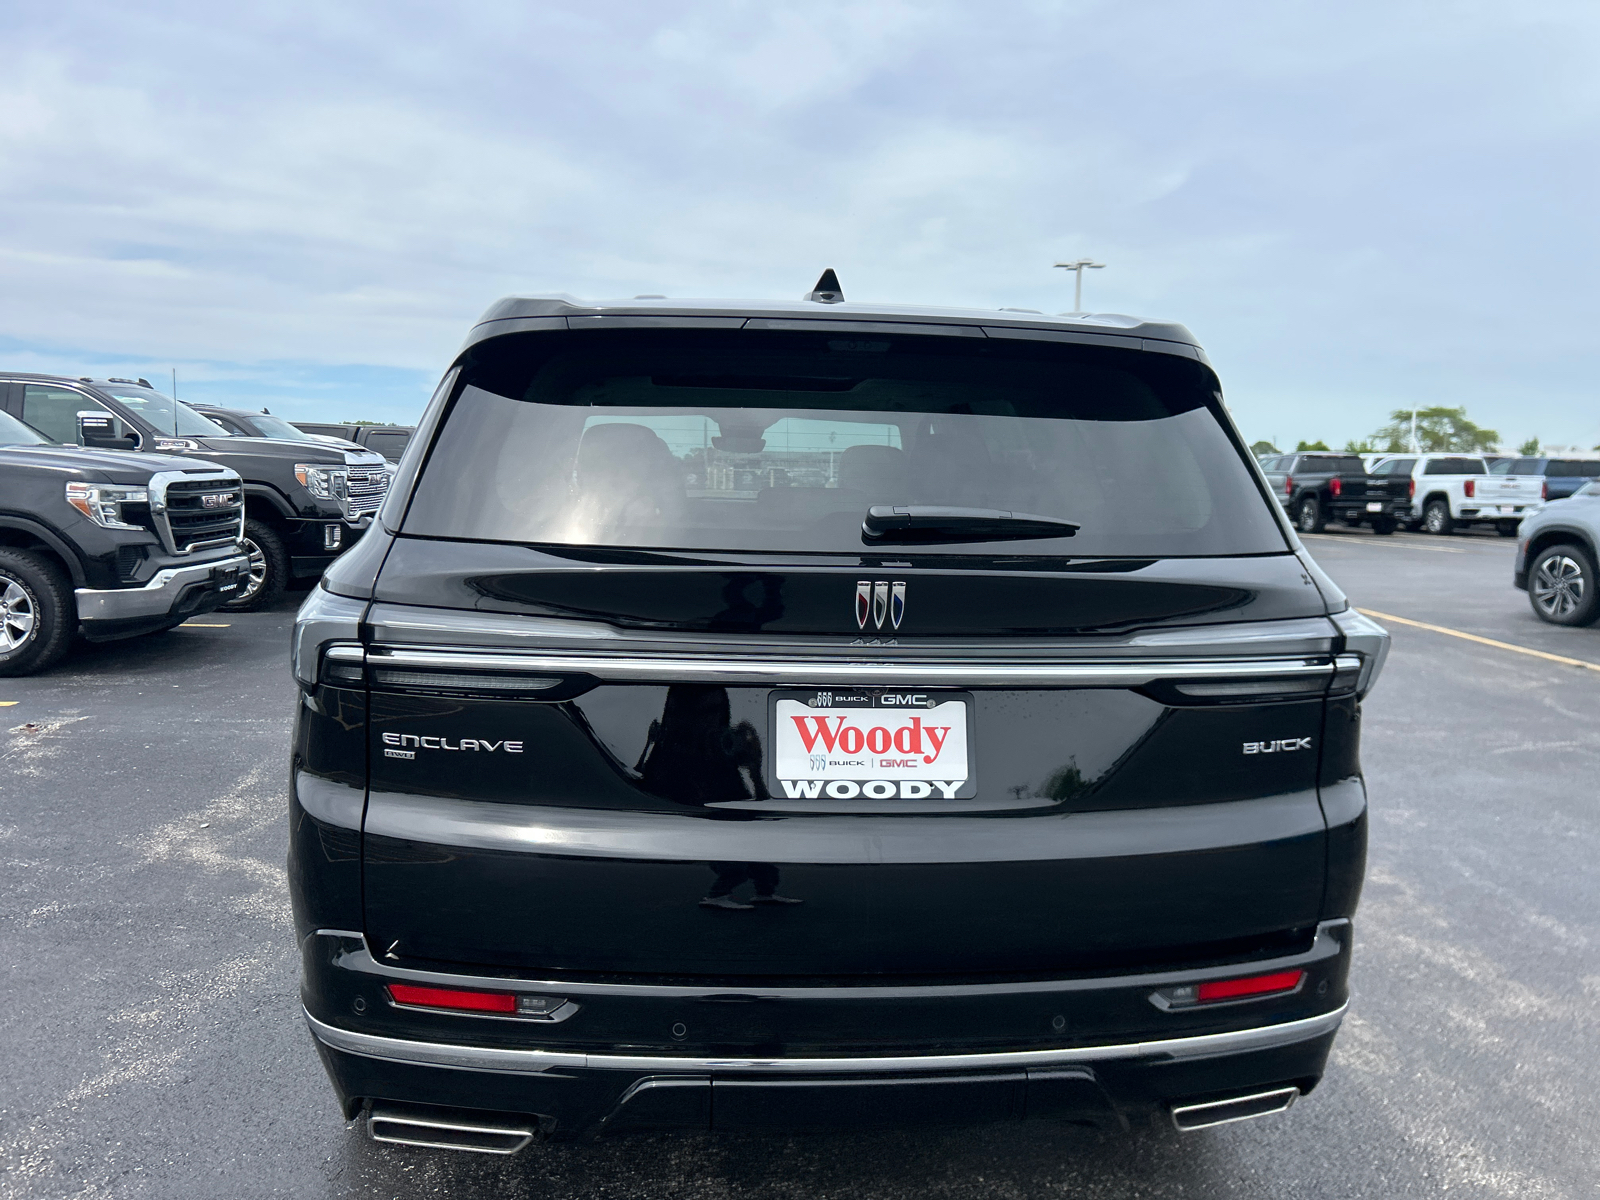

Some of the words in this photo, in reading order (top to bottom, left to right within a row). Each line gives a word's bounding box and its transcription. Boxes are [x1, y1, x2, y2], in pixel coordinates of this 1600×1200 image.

[201, 493, 234, 508] GMC
[881, 694, 928, 706] GMC
[382, 732, 524, 753] ENCLAVE
[790, 715, 952, 764] Woody
[1243, 736, 1312, 755] BUICK
[385, 750, 415, 759] AWD
[880, 758, 918, 768] GMC
[780, 780, 966, 799] WOODY
